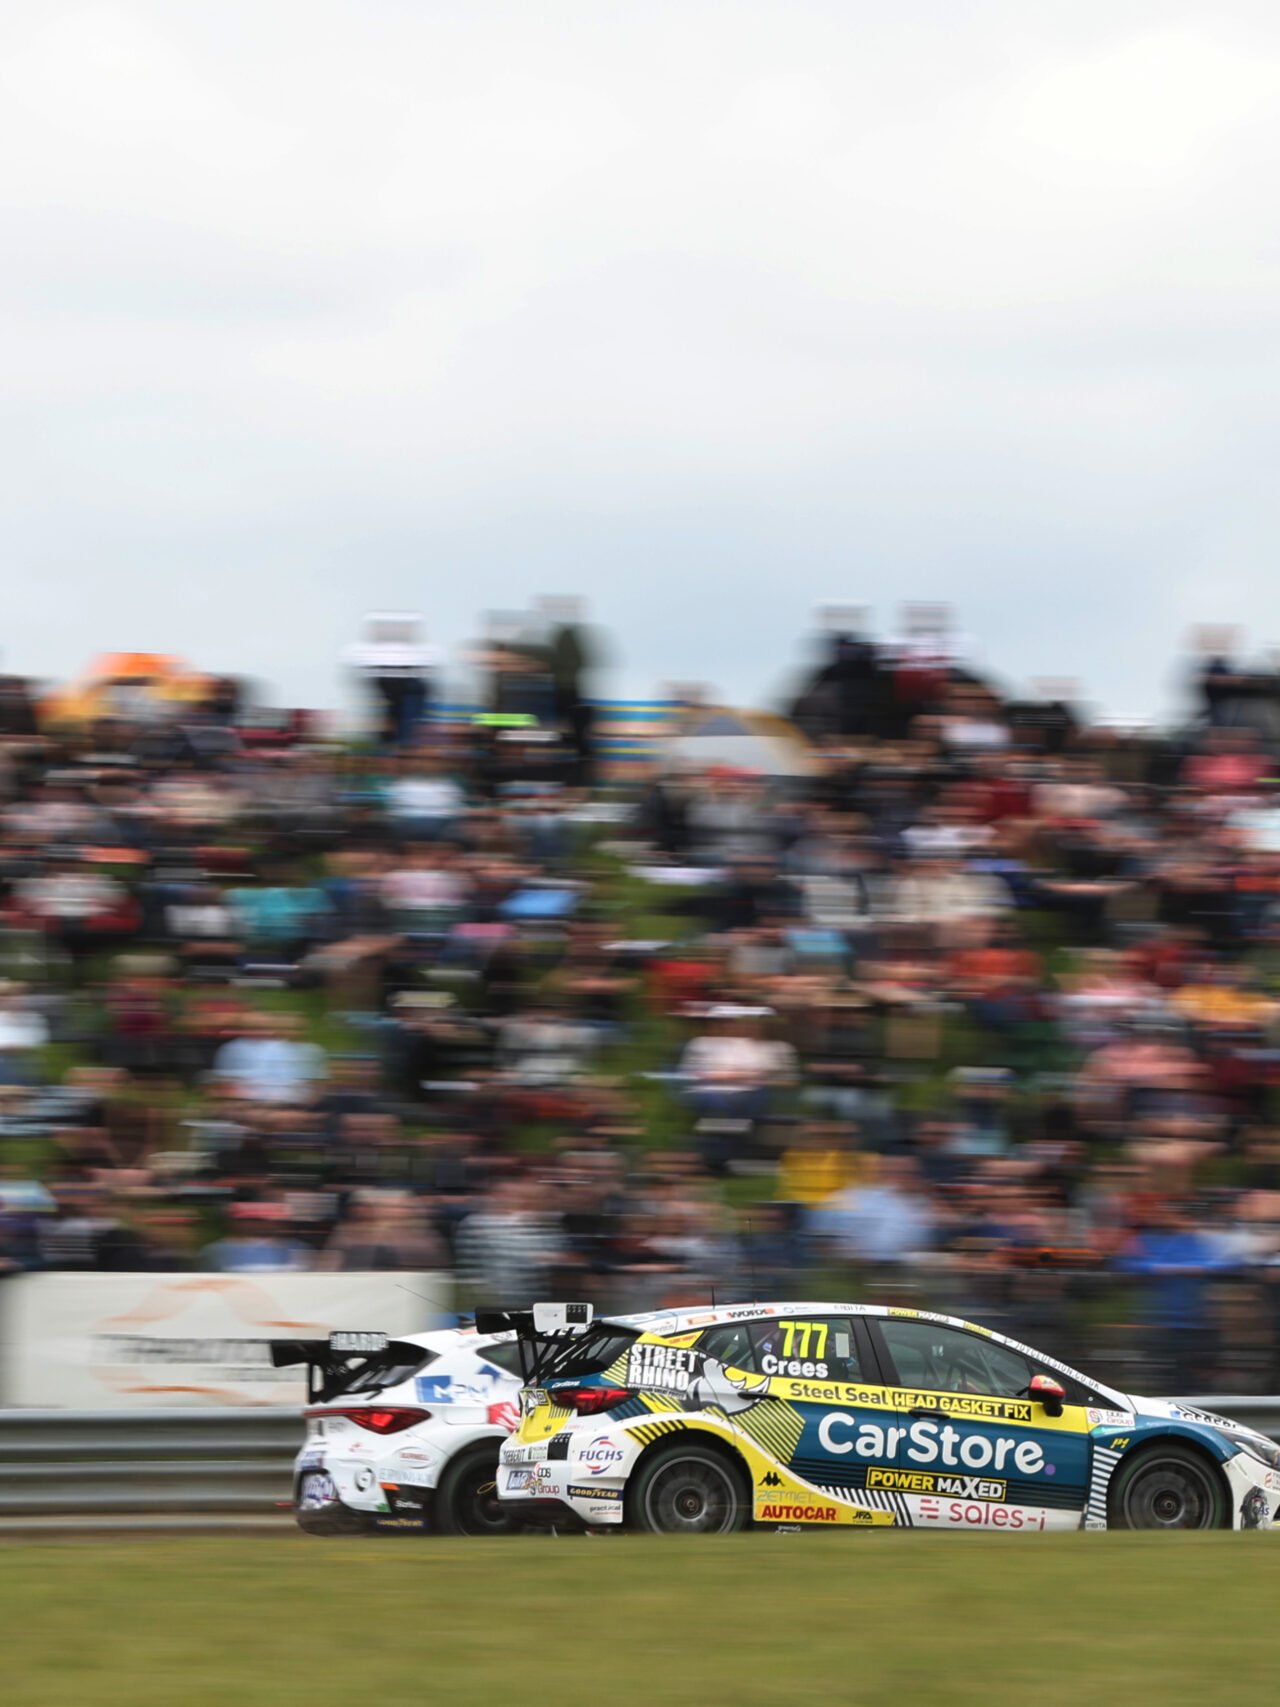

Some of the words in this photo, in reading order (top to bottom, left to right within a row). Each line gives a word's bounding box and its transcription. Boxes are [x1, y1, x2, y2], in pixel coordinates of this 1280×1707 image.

[779, 1321, 828, 1359] 777
[630, 1344, 698, 1373] STREET
[761, 1354, 828, 1378] Crees
[629, 1364, 689, 1391] RHINO
[790, 1383, 841, 1400] Steel
[845, 1387, 888, 1405] Seal
[894, 1393, 937, 1409] HEAD
[940, 1399, 1001, 1417] GASKET
[1005, 1404, 1029, 1419] FIX
[579, 1450, 624, 1461] FUCHS
[538, 1484, 560, 1496] Group
[570, 1487, 618, 1498] GOODYEAR
[870, 1471, 933, 1490] POWER
[937, 1477, 1003, 1498] MAXED
[762, 1505, 836, 1520] AUTOCAR
[949, 1502, 1046, 1530] sales-i
